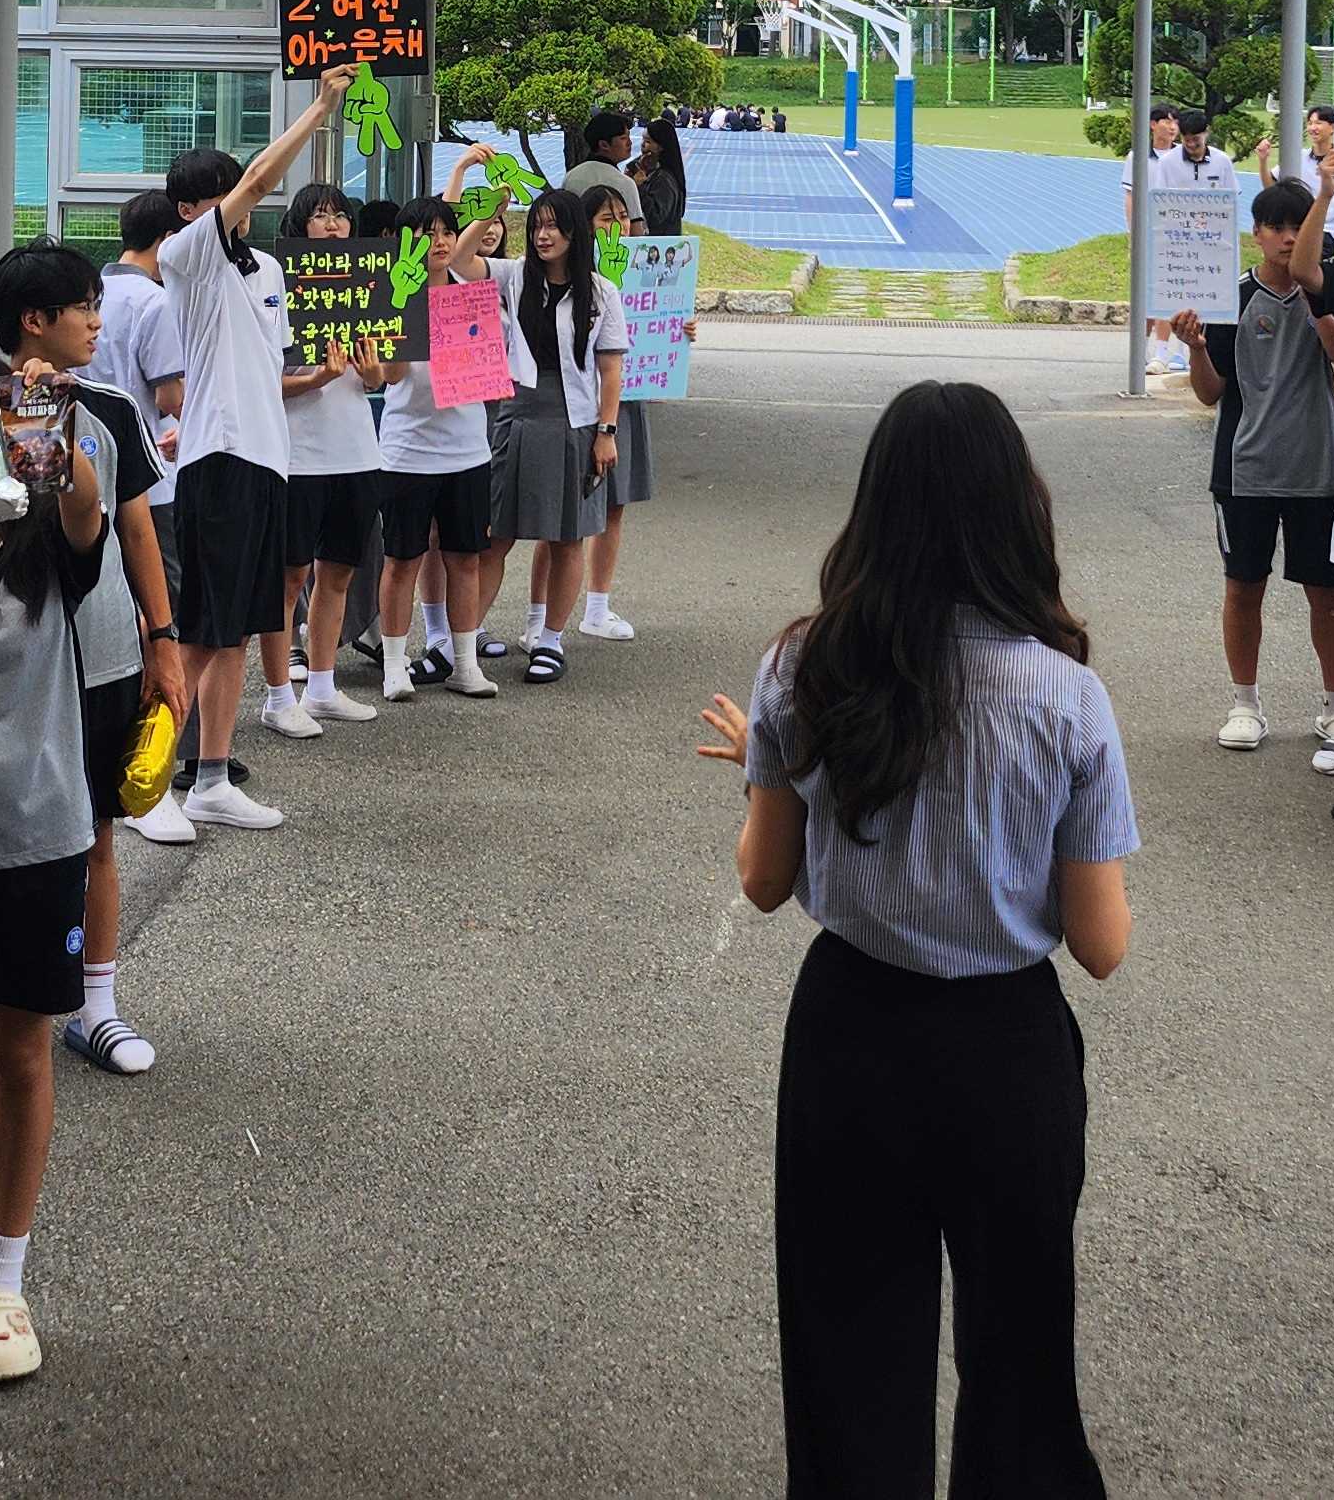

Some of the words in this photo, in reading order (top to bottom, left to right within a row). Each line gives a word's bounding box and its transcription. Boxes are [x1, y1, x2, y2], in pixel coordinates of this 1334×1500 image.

[358, 252, 391, 273] 데이
[621, 292, 658, 311] 아타
[303, 343, 316, 364] 및
